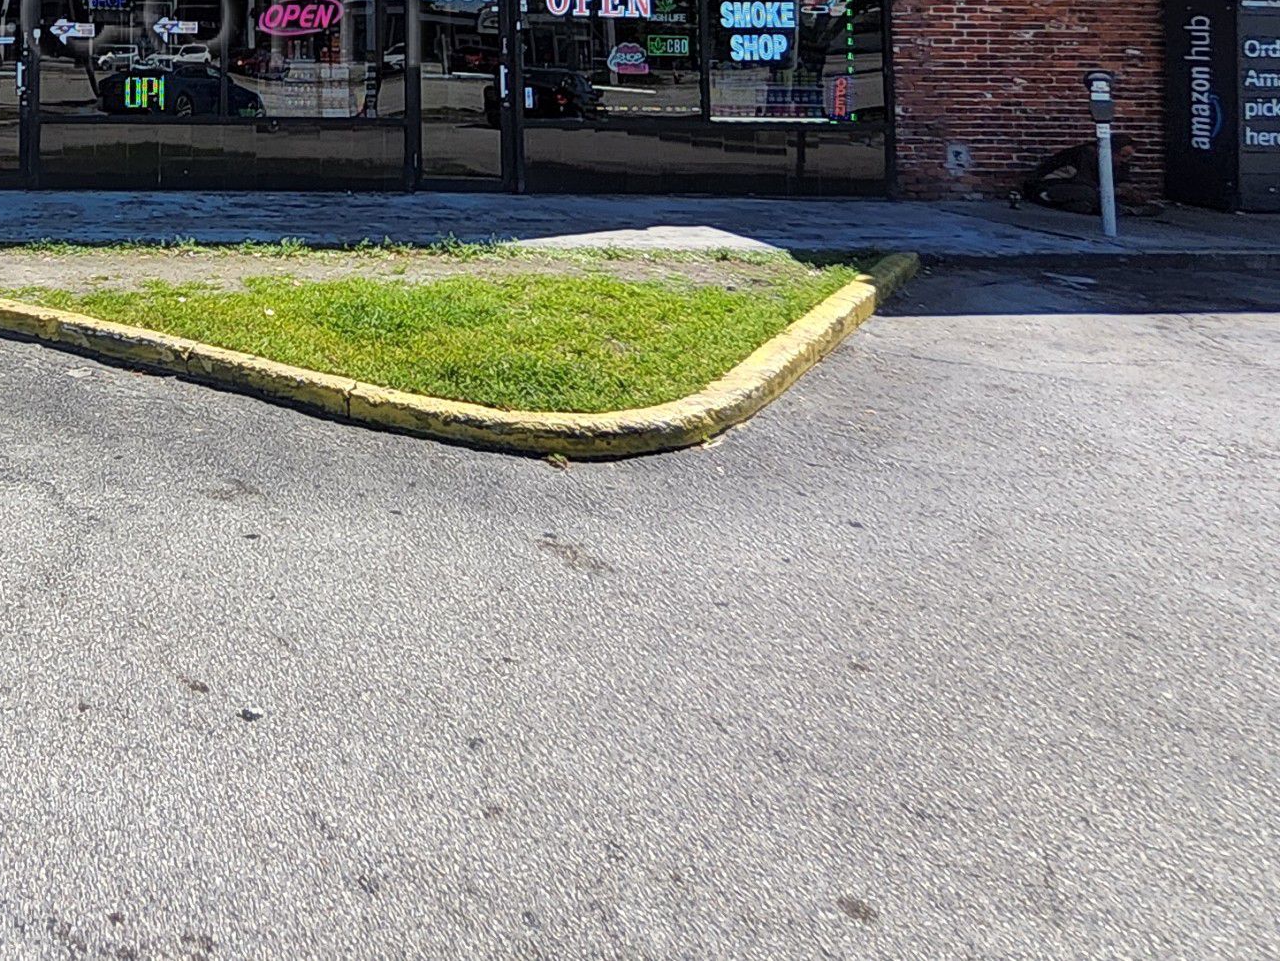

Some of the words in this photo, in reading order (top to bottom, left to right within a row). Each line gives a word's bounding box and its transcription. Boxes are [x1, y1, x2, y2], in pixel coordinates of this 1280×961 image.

[265, 4, 335, 29] OPEN
[720, 1, 796, 28] SMOKE
[730, 34, 788, 61] SHOP
[1183, 14, 1211, 61] hub
[1244, 69, 1280, 87] Am
[1190, 66, 1211, 151] amazon
